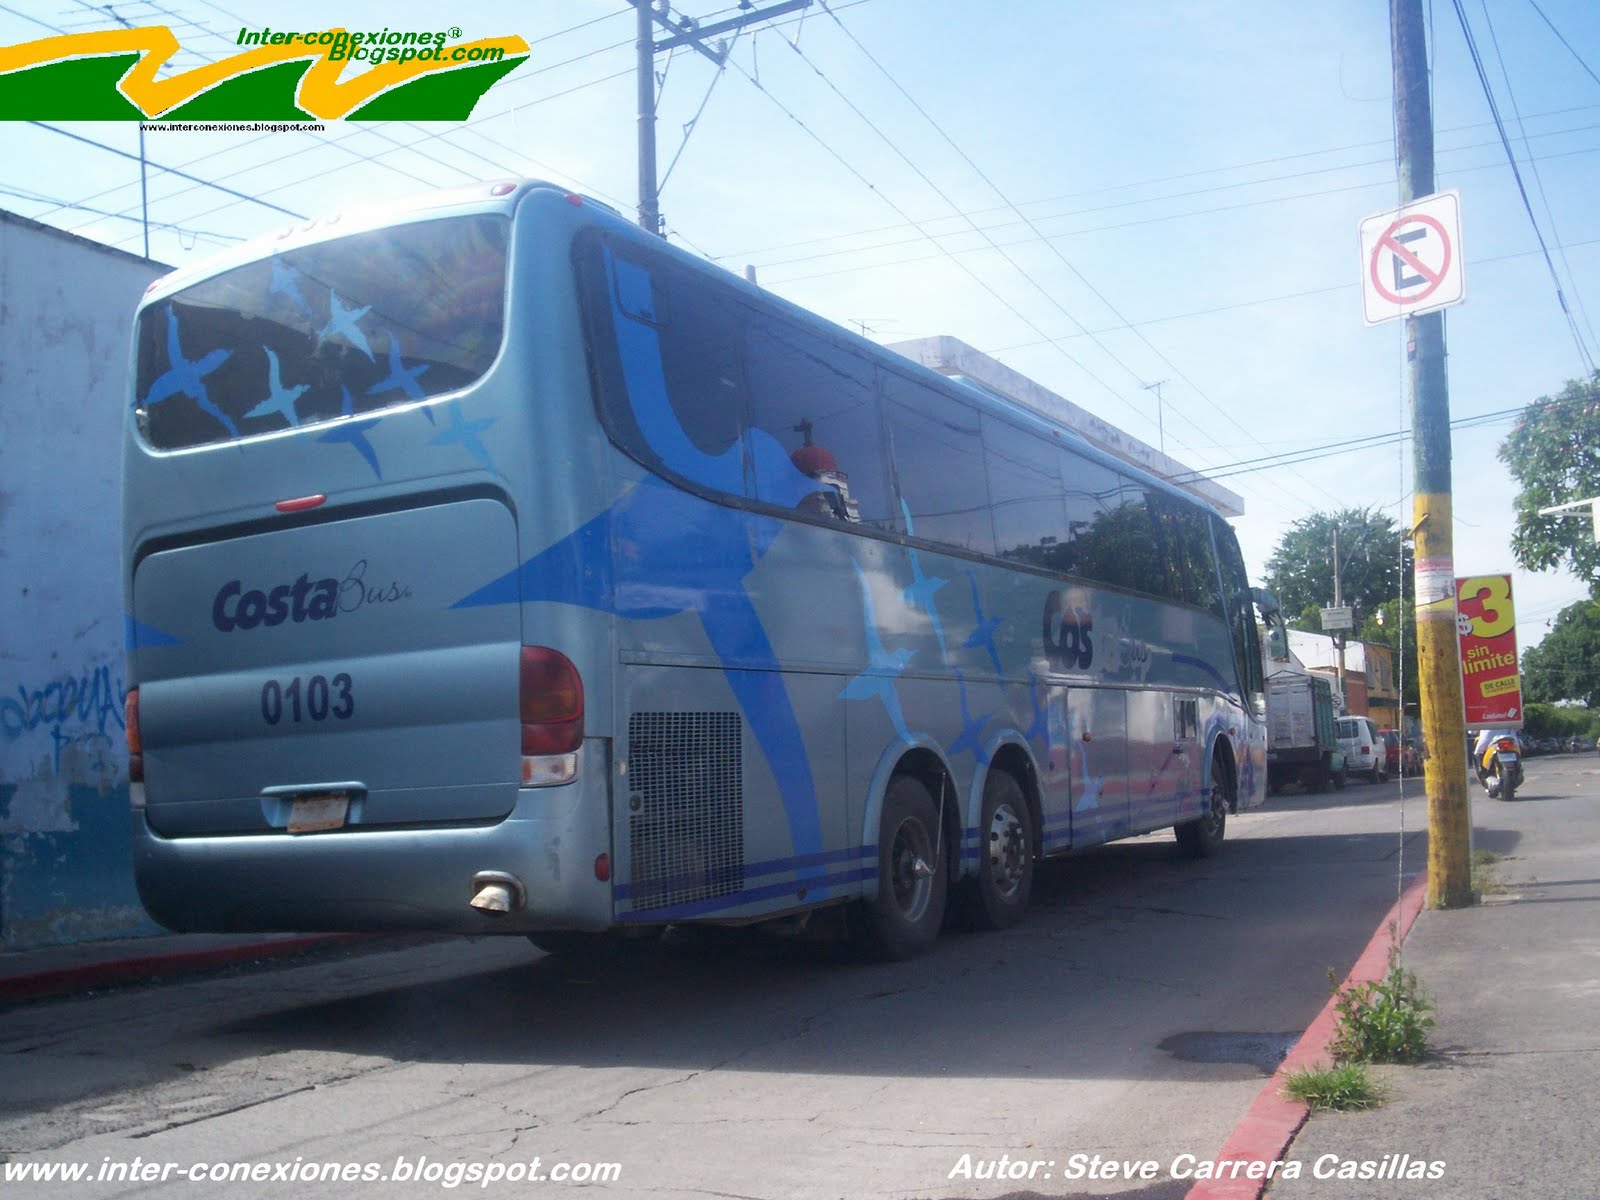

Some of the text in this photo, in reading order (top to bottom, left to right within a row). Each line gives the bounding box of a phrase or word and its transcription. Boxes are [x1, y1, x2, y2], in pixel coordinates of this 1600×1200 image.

[1463, 652, 1516, 675] limite
[1467, 645, 1490, 659] sin
[262, 673, 354, 726] 0103
